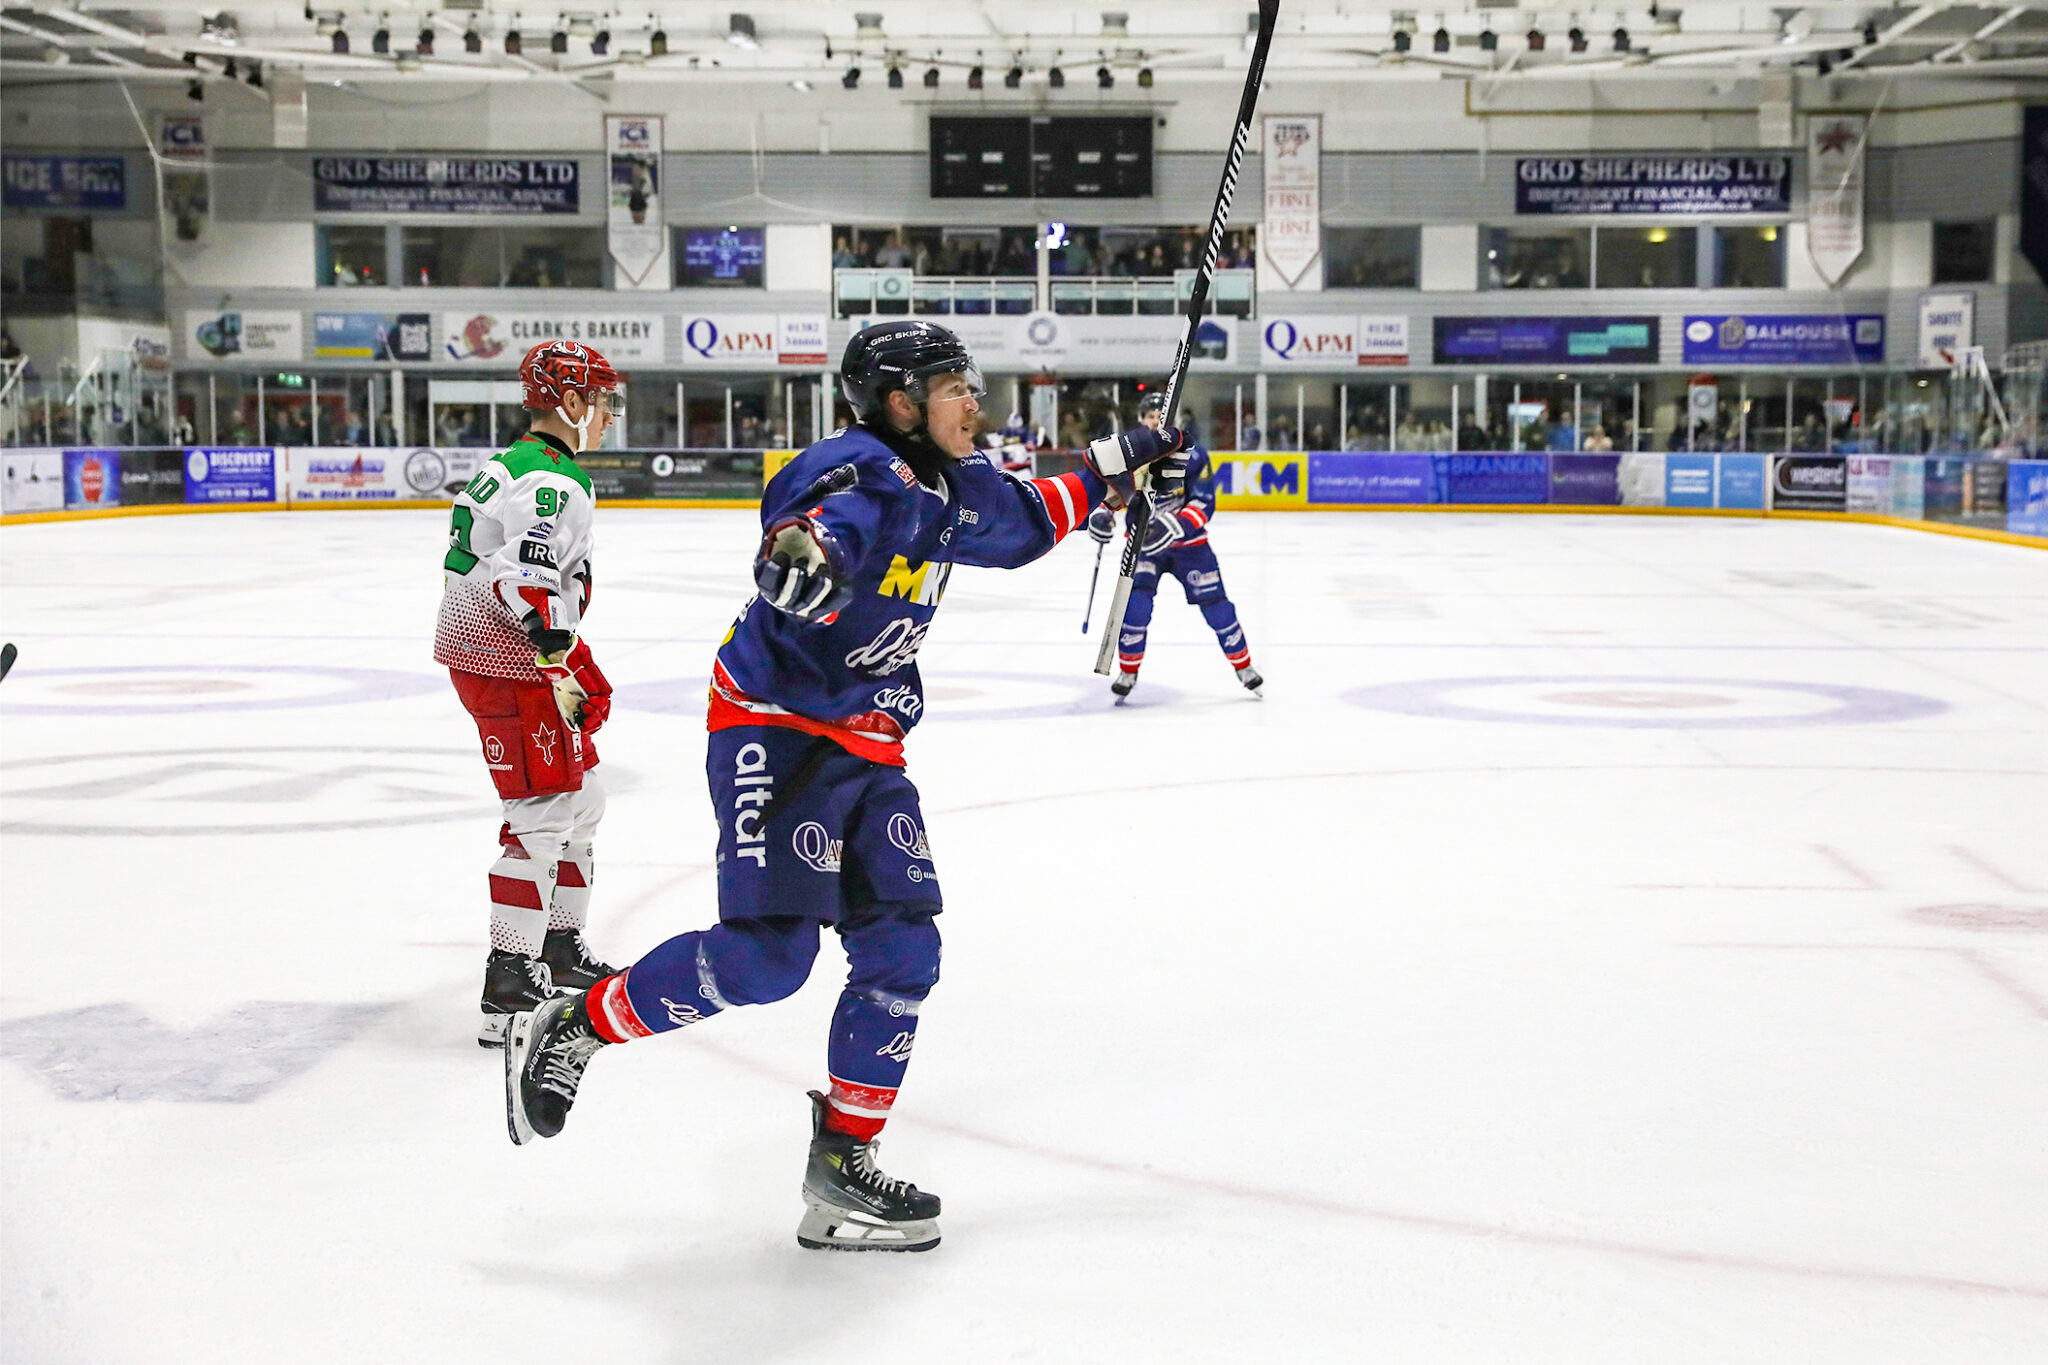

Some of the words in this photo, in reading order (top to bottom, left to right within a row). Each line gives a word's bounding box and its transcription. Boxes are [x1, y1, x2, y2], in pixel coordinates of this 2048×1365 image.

[317, 159, 371, 181] GKD
[376, 159, 522, 183] SHEPHERDS
[528, 160, 574, 184] LTD
[1520, 159, 1575, 181] GKD
[1580, 159, 1732, 182] SHEPHERDS
[1737, 159, 1786, 181] LTD
[511, 188, 566, 202] ADVICE
[1201, 120, 1250, 283] WARRIOR
[1633, 186, 1717, 201] FINANCIAL
[511, 320, 581, 339] CLARK'S
[587, 320, 652, 339] BAKERY
[685, 317, 773, 359] QAPM
[870, 334, 893, 347] GRC
[894, 329, 929, 340] SKIPS
[1744, 324, 1851, 341] BALHOUSIE
[1264, 319, 1353, 361] QAPM
[209, 452, 272, 467] DISCOVERY
[1451, 456, 1547, 473] BRANKIN
[1212, 461, 1299, 495] MKM
[1313, 474, 1365, 488] University
[1366, 474, 1379, 486] of
[1380, 475, 1422, 487] Dundee
[877, 553, 951, 607] MK
[735, 742, 774, 868] altar
[571, 965, 598, 979] BAUER
